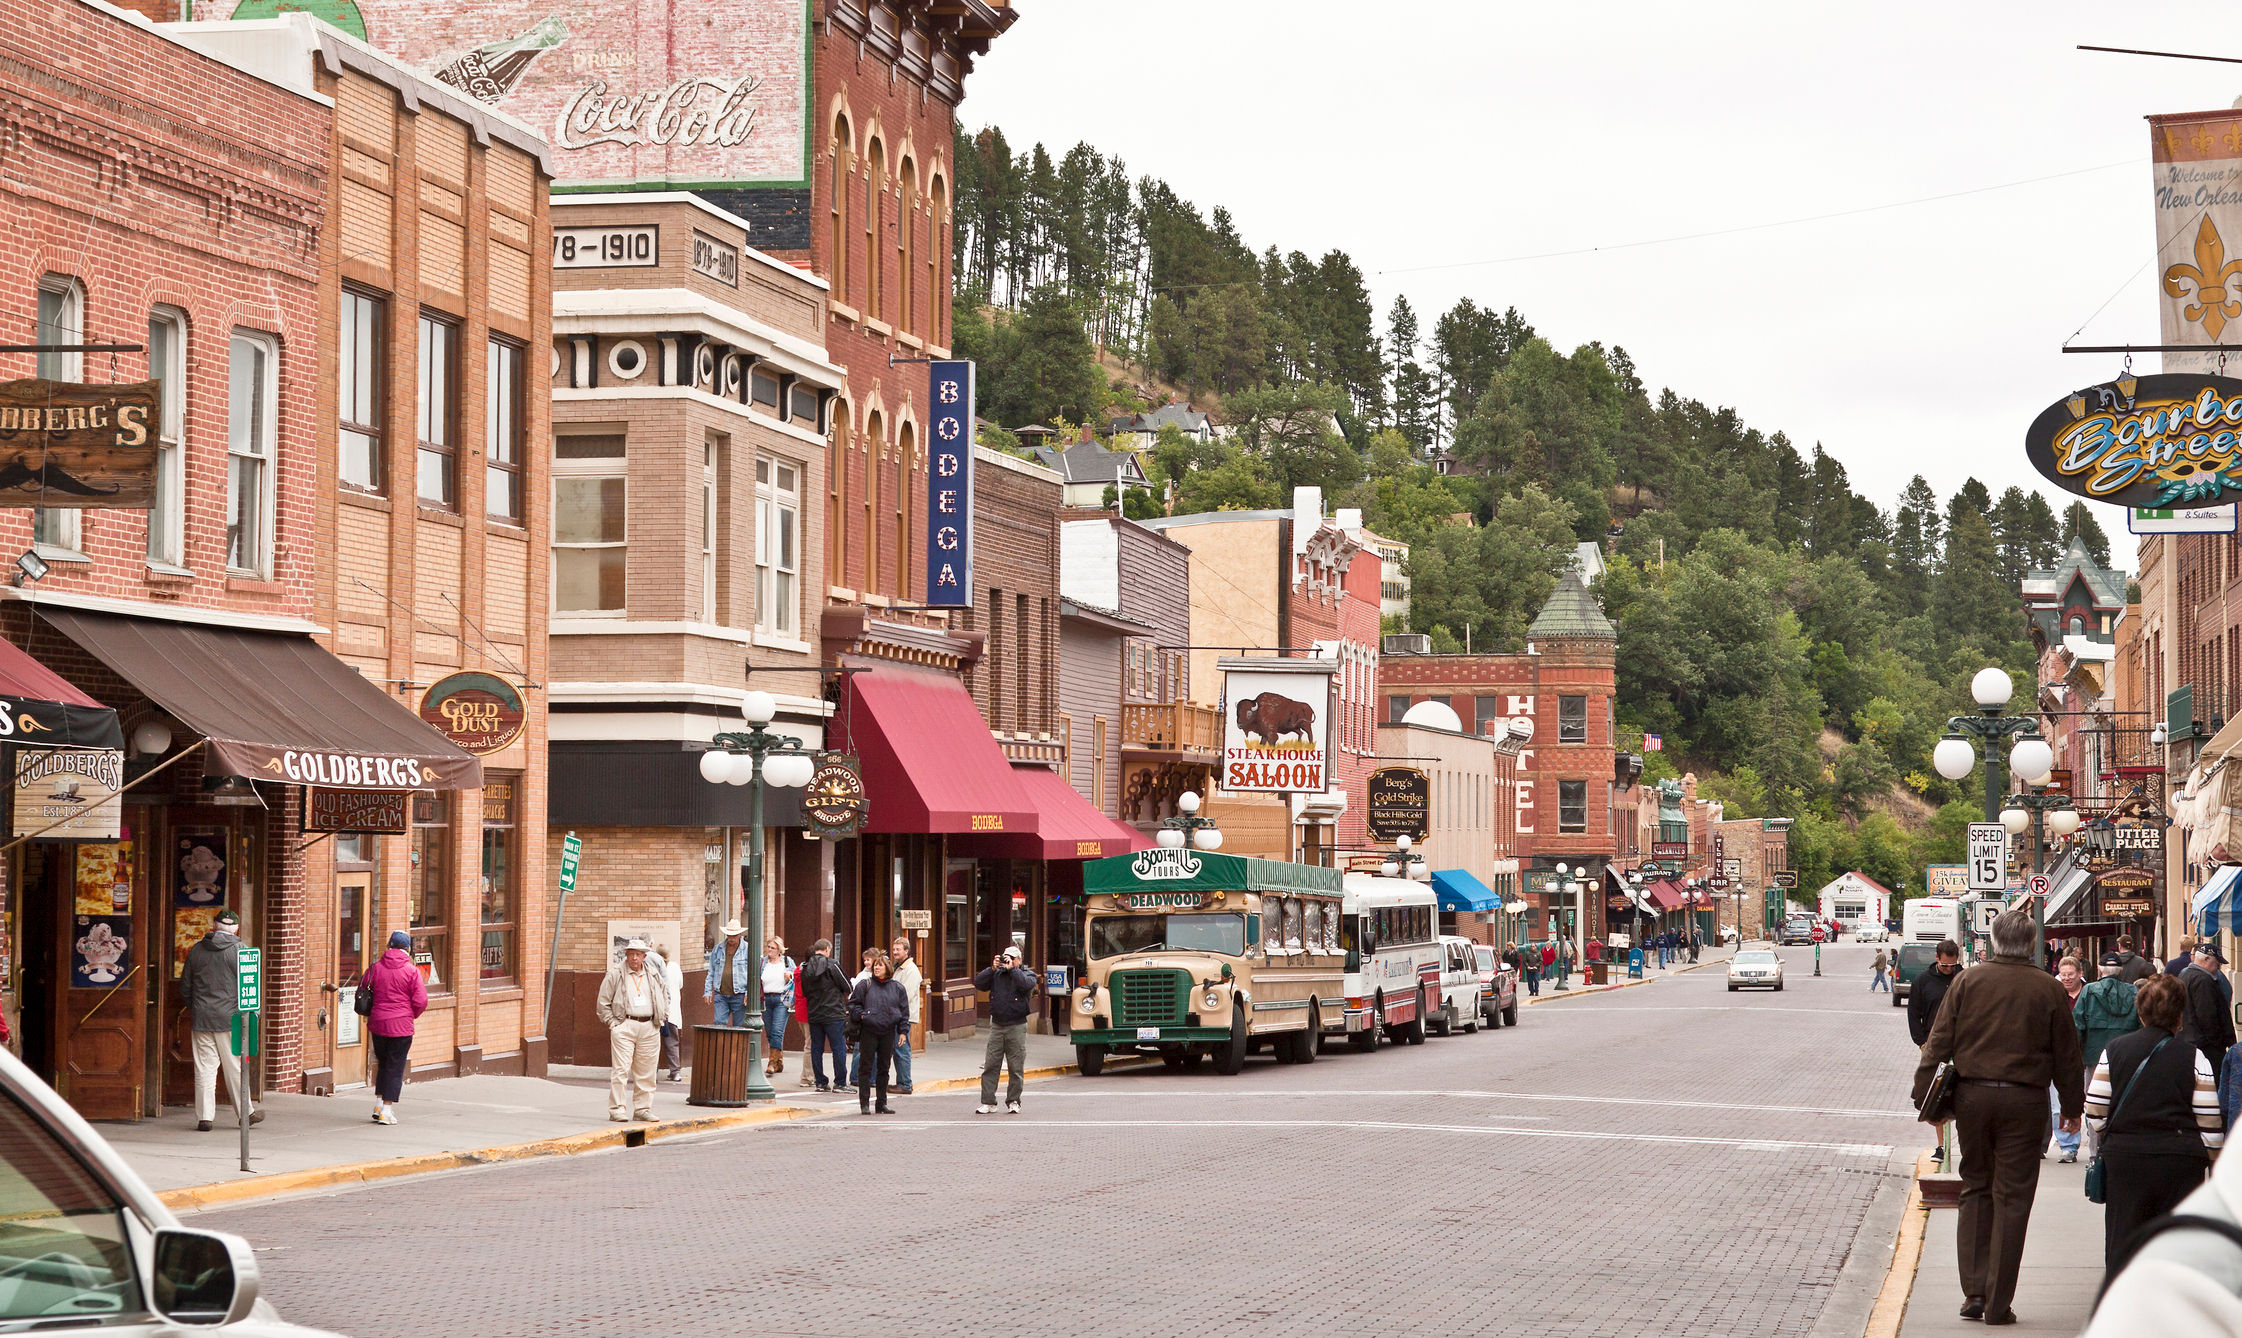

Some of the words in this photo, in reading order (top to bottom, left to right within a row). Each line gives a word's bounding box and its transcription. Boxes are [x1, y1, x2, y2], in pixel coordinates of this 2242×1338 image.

[573, 52, 637, 69] DRINK
[556, 73, 763, 150] Coca-Cola
[2169, 165, 2224, 183] Welcome
[2227, 166, 2241, 181] to
[2156, 185, 2193, 210] New
[937, 380, 959, 588] BODEGA
[2193, 510, 2218, 519] Suites
[440, 698, 498, 719] GOLD
[452, 714, 503, 733] DUST
[470, 736, 487, 748] and
[488, 727, 516, 747] Liquor
[1228, 748, 1324, 761] STEAKHOUSE
[284, 750, 422, 787] GOLDBERG'S
[1228, 762, 1322, 789] SALOON
[807, 767, 860, 794] DEADWOOD
[1385, 777, 1413, 789] Berg's
[314, 793, 337, 813] OLD
[339, 794, 403, 813] FASHIONED
[805, 796, 861, 808] GIFT
[1374, 792, 1396, 802] Gold
[1397, 792, 1424, 802] Strike
[314, 811, 340, 827] ICE
[346, 807, 403, 827] CREAM
[813, 809, 851, 822] SHOPPE
[971, 815, 1004, 830] BODEGA
[1971, 830, 2003, 842] SPEED
[2115, 829, 2160, 839] UTTER
[1077, 842, 1102, 856] BODEGA
[2115, 839, 2160, 849] PLACE
[1973, 846, 2000, 858] LIMIT
[1153, 866, 1180, 877] TOURS
[1975, 859, 1998, 883] 15
[1932, 878, 1969, 886] GIVEA
[2101, 879, 2153, 887] RESTAURANT
[1130, 894, 1202, 908] DEADWOOD
